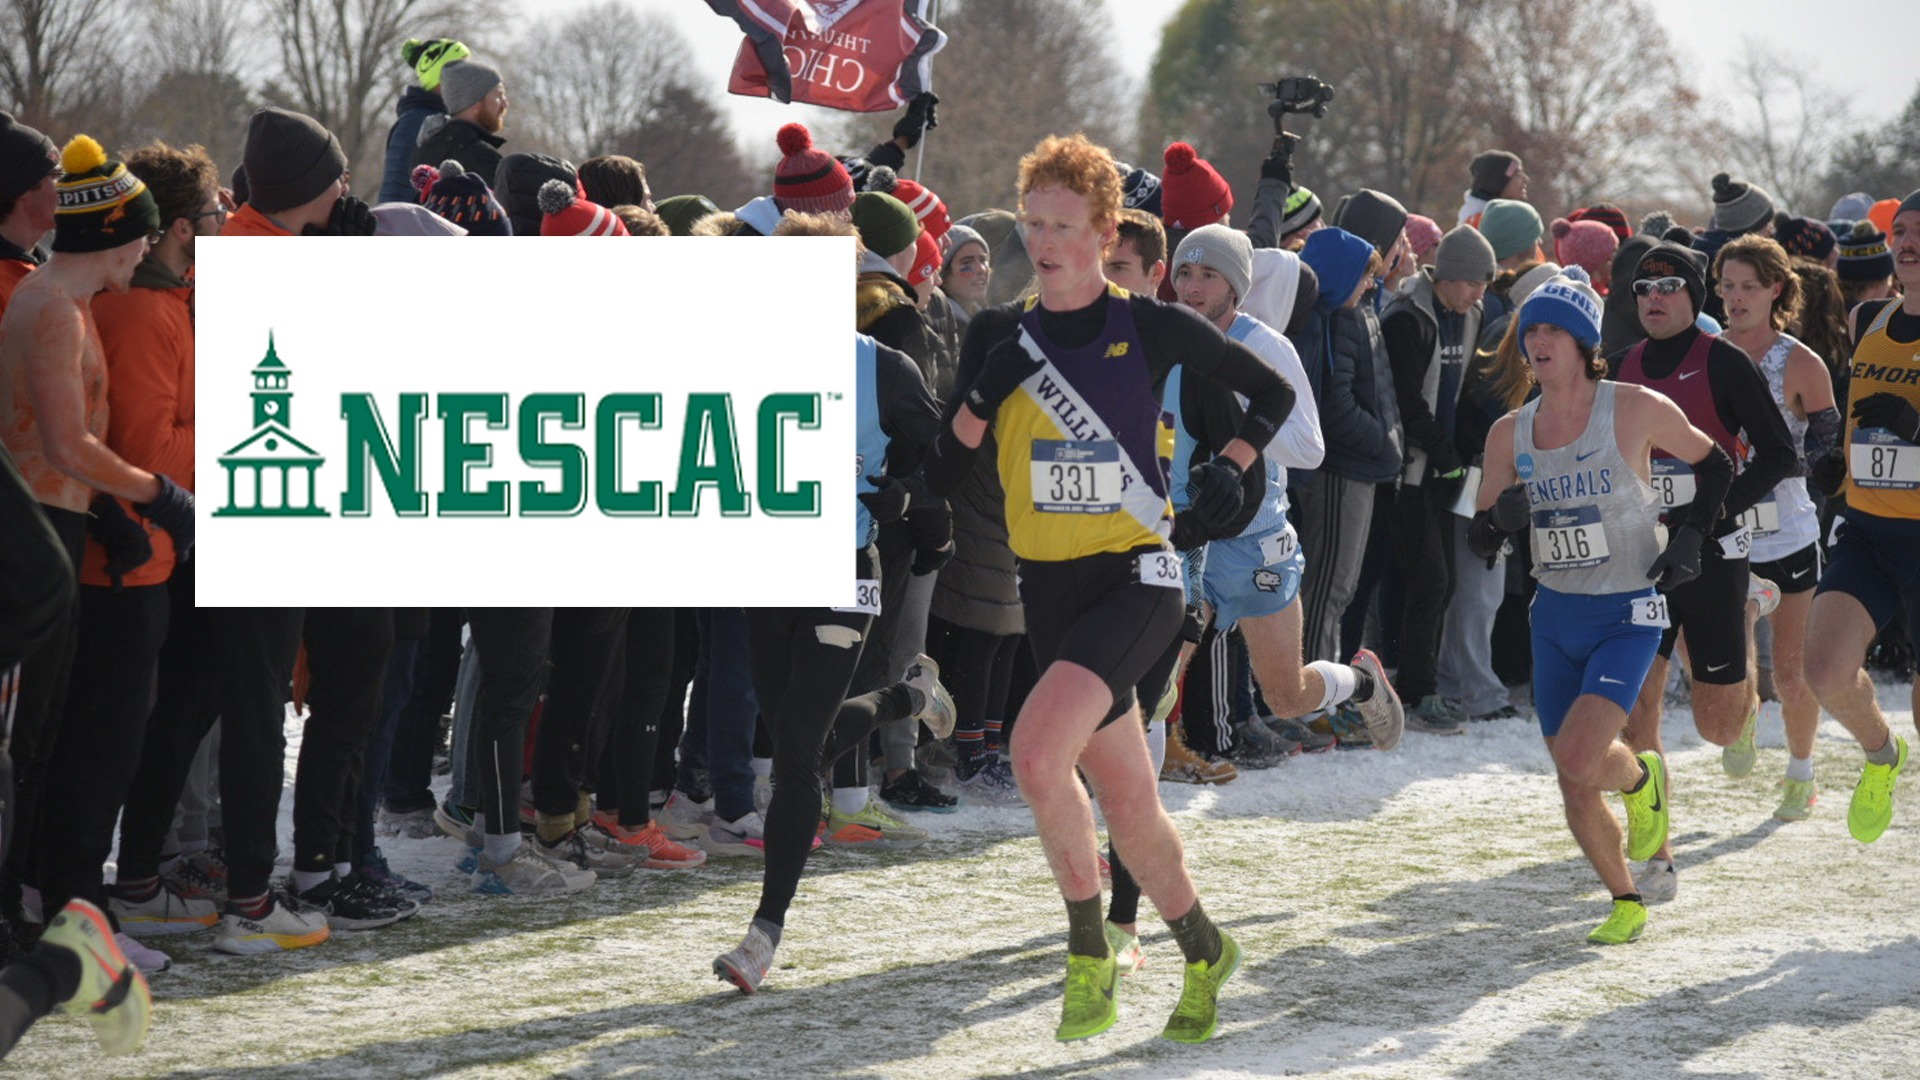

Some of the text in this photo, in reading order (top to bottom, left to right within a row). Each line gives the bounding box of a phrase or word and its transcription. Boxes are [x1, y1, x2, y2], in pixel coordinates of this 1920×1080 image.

[1104, 341, 1129, 358] NB
[1852, 362, 1920, 386] EMOR
[1037, 374, 1134, 492] WILLS
[1872, 447, 1898, 479] 87
[1050, 464, 1100, 502] 331
[1526, 468, 1612, 506] ENERALS
[1276, 533, 1293, 556] 72
[1548, 528, 1591, 561] 316
[1646, 601, 1666, 621] 31
